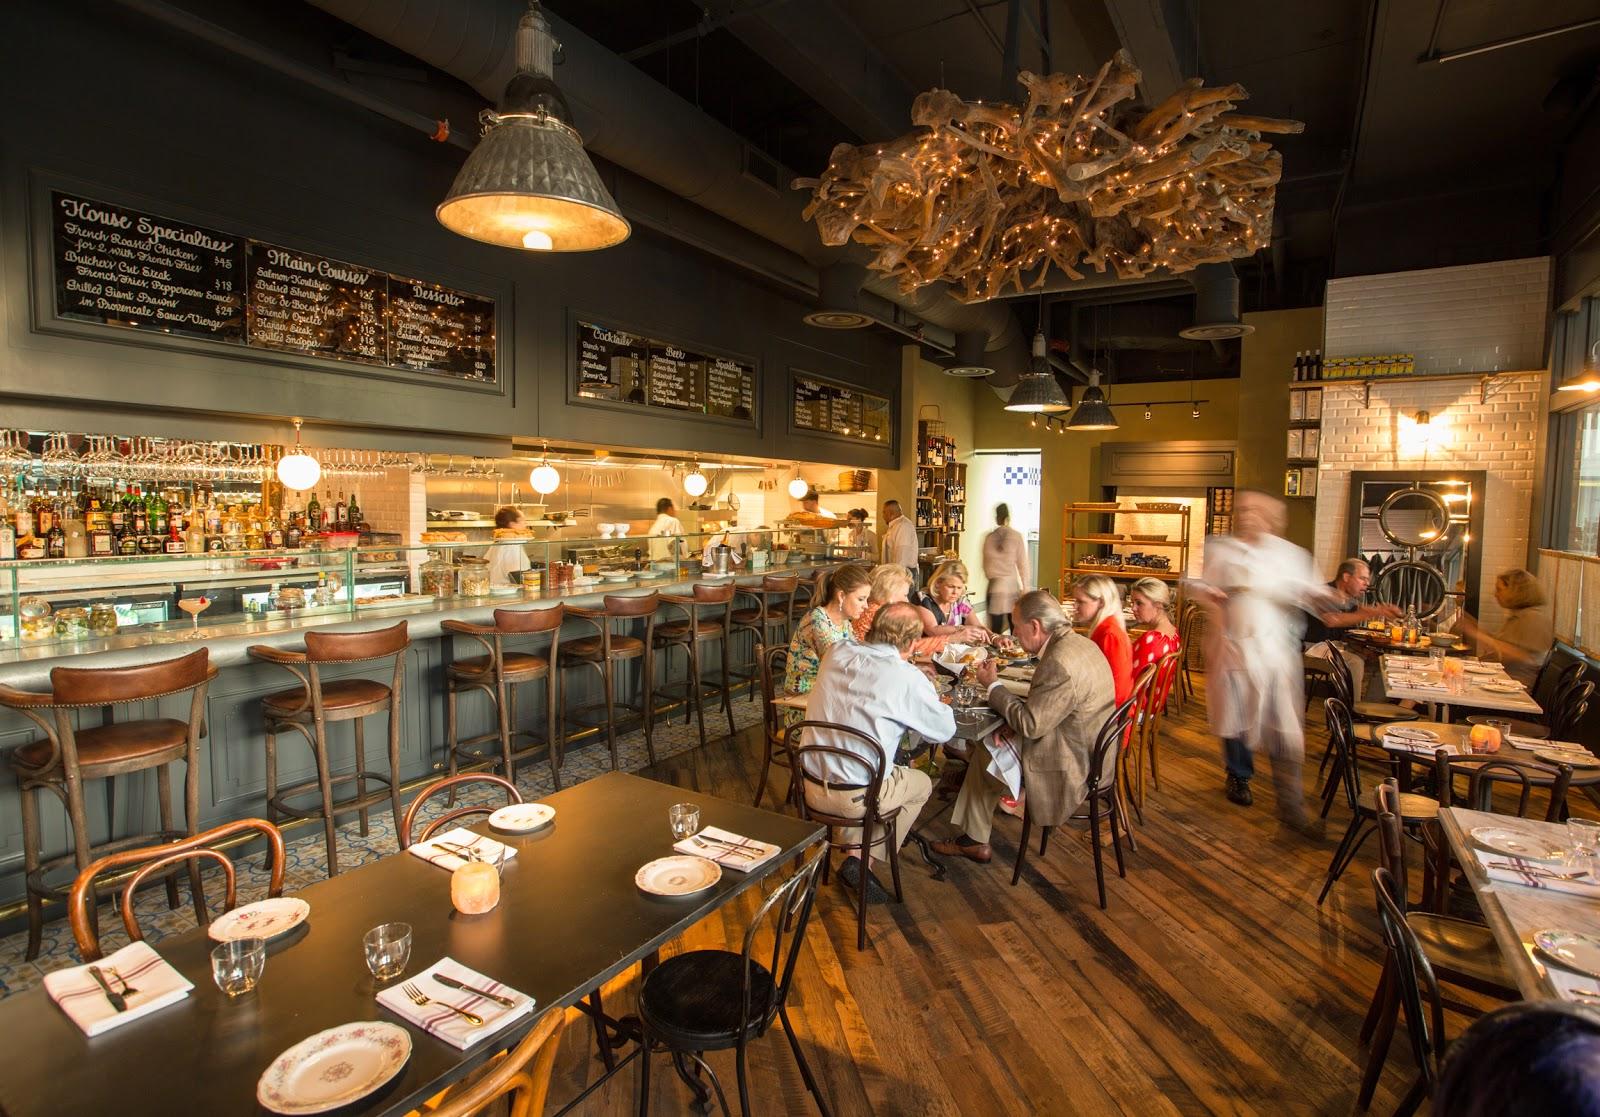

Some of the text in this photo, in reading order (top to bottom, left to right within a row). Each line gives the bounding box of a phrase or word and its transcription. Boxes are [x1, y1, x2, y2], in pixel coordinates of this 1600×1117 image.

[61, 199, 234, 253] House Specialties
[64, 222, 232, 269] French Roasted Chicken $45
[75, 239, 96, 252] for
[109, 247, 136, 259] with
[137, 252, 174, 267] French
[175, 258, 203, 273] Fries
[118, 260, 140, 274] Cut
[142, 263, 172, 281] Steak
[215, 279, 232, 291] $18
[257, 266, 290, 282] Salmon
[267, 249, 369, 286] Main Courses
[66, 279, 102, 295] Grilled
[105, 286, 135, 301] Giant
[136, 292, 180, 309] Prawns
[76, 265, 118, 282] French
[151, 280, 204, 298] Peppercorn
[205, 289, 234, 303] Sauce
[255, 279, 288, 294] Braised
[412, 285, 465, 306] Desserts
[78, 297, 95, 307] in
[156, 308, 187, 323] Sauce
[256, 305, 290, 320] French
[257, 317, 289, 333] Hanger
[290, 323, 314, 336] Steak
[593, 328, 633, 347] Cocktails
